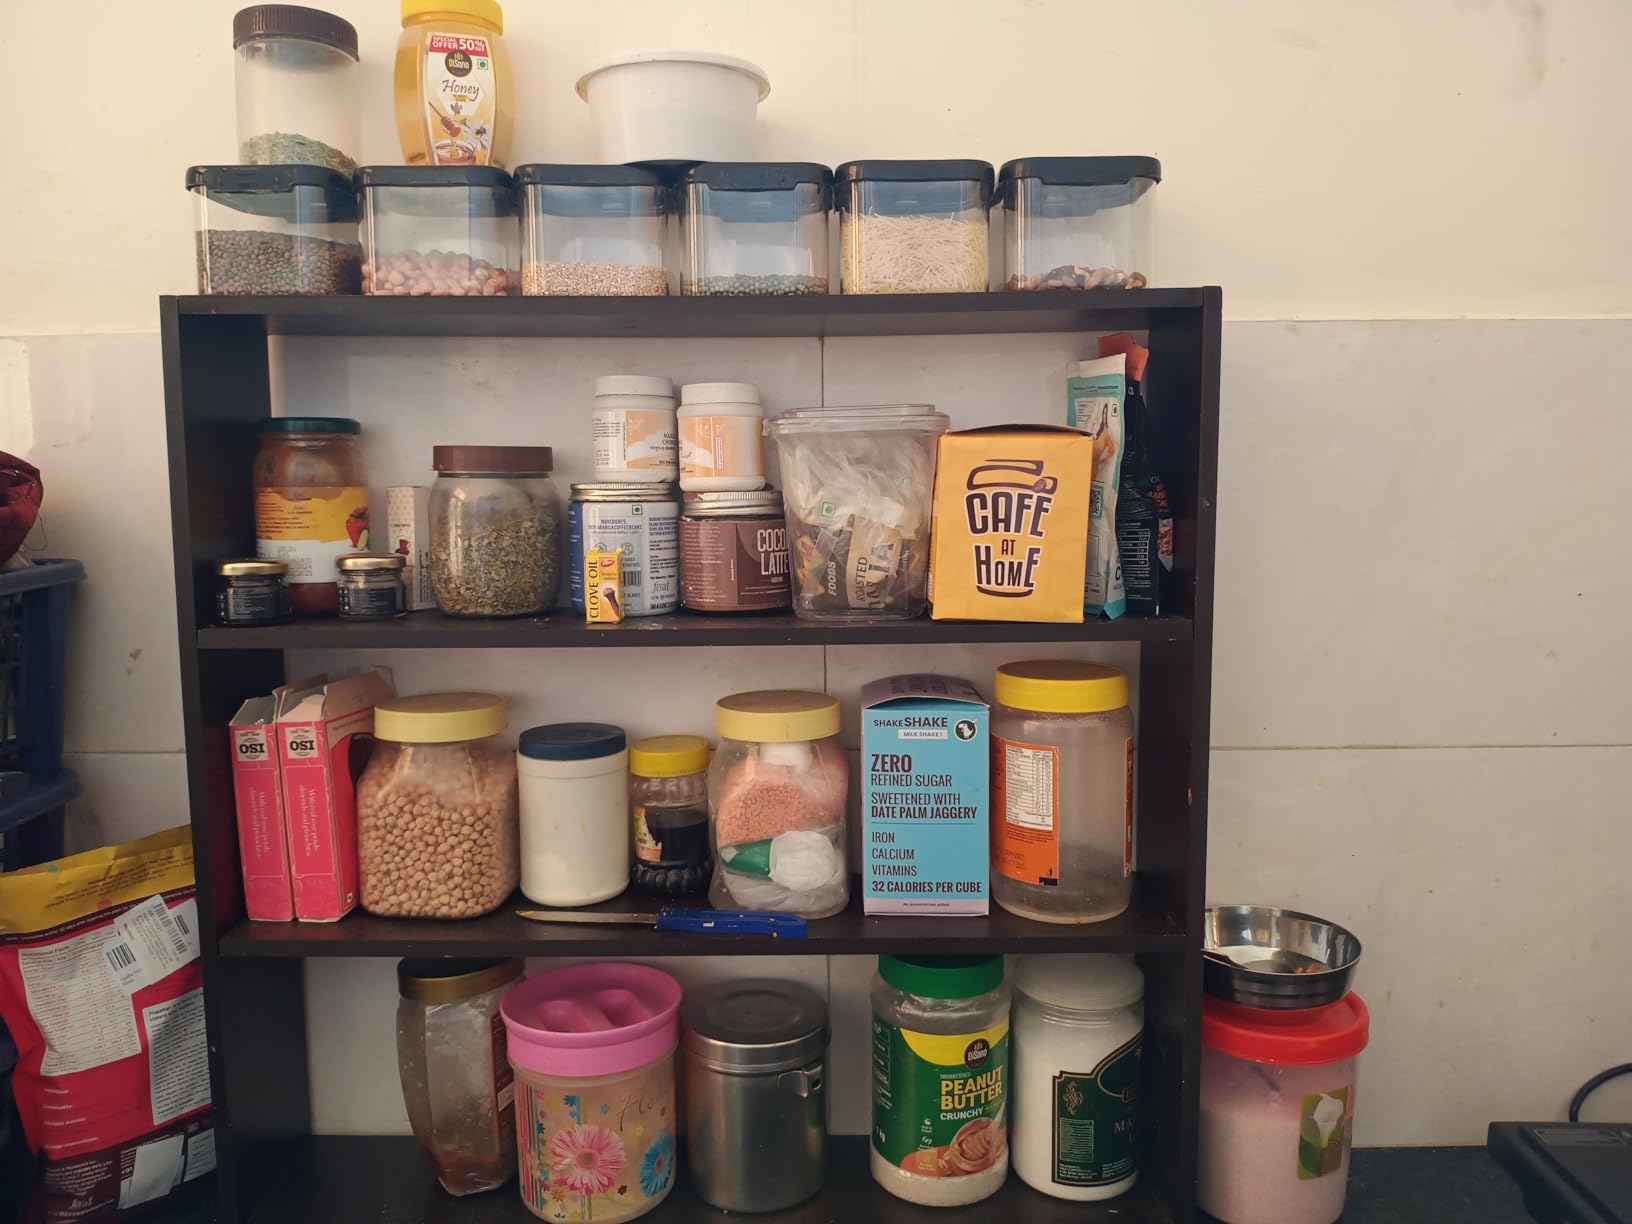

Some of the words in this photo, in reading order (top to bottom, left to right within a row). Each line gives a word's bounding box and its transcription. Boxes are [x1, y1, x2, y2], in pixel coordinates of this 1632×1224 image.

[432, 41, 458, 49] OFFER
[442, 79, 479, 102] Honey
[965, 491, 1052, 538] CAFE
[1001, 539, 1016, 556] AT
[588, 559, 598, 579] OIL
[761, 551, 788, 576] LATTE
[974, 545, 1041, 588] HOME
[826, 560, 837, 597] FOODS
[855, 556, 868, 602] ROASTED
[589, 581, 599, 618] CLOVE
[871, 753, 912, 773] ZERO
[871, 773, 912, 787] REFINED
[915, 774, 953, 787] SUGAR
[871, 792, 931, 805] SWEETENED
[933, 793, 961, 805] WITH
[871, 805, 897, 819] DATE
[899, 806, 928, 819] PALM
[929, 806, 977, 819] JAGGERY
[871, 831, 895, 844] IRON
[871, 848, 915, 860] CALCIUM
[871, 864, 918, 877] VITAMINS
[872, 880, 885, 892] 32
[887, 880, 934, 893] CALORIES
[935, 881, 954, 893] PER
[955, 881, 983, 893] CUBE
[967, 1048, 988, 1061] DiSano
[941, 1065, 1003, 1096] PEANUT
[941, 1081, 1002, 1111] BUTTER
[940, 1106, 984, 1121] CRUNCHY
